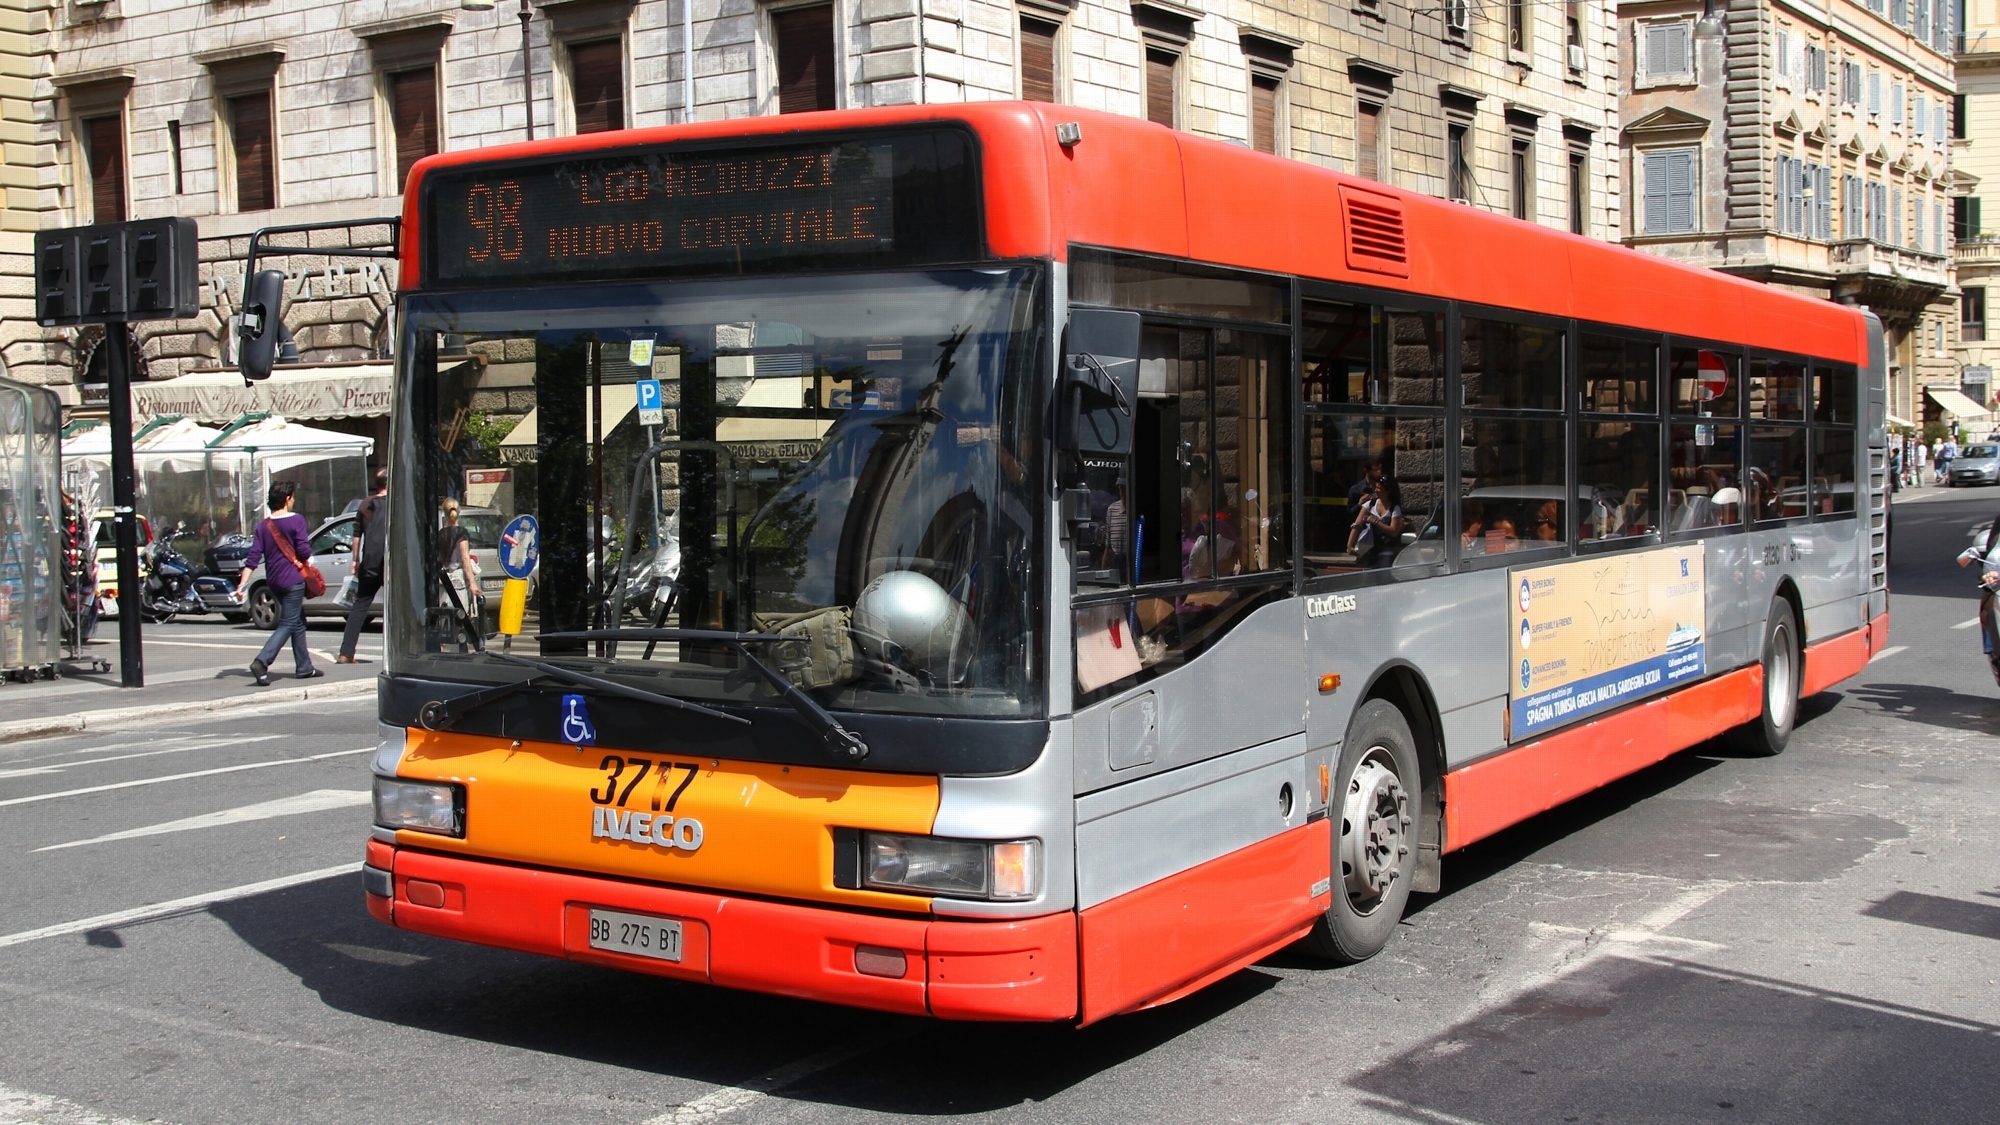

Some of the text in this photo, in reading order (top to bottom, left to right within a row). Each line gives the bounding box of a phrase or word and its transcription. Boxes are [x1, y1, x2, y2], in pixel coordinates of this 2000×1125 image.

[582, 154, 832, 204] LGO REDUZZI
[469, 180, 523, 263] 98
[550, 206, 875, 257] NUOVO CORVIALE
[138, 396, 201, 415] Ristorante
[641, 383, 656, 407] P
[778, 443, 817, 458] GELATO
[1307, 594, 1357, 618] CityClass
[1527, 707, 1554, 726] SPAGNA
[1554, 699, 1577, 717] TUNISIA
[1577, 690, 1597, 708] GRECIA
[1597, 683, 1617, 702] MALTA
[1617, 674, 1645, 696] SARDEGNA
[1645, 668, 1661, 685] SICILIA
[590, 755, 699, 812] 3717
[593, 806, 704, 851] IVECO
[591, 918, 680, 953] BB 275 BT
